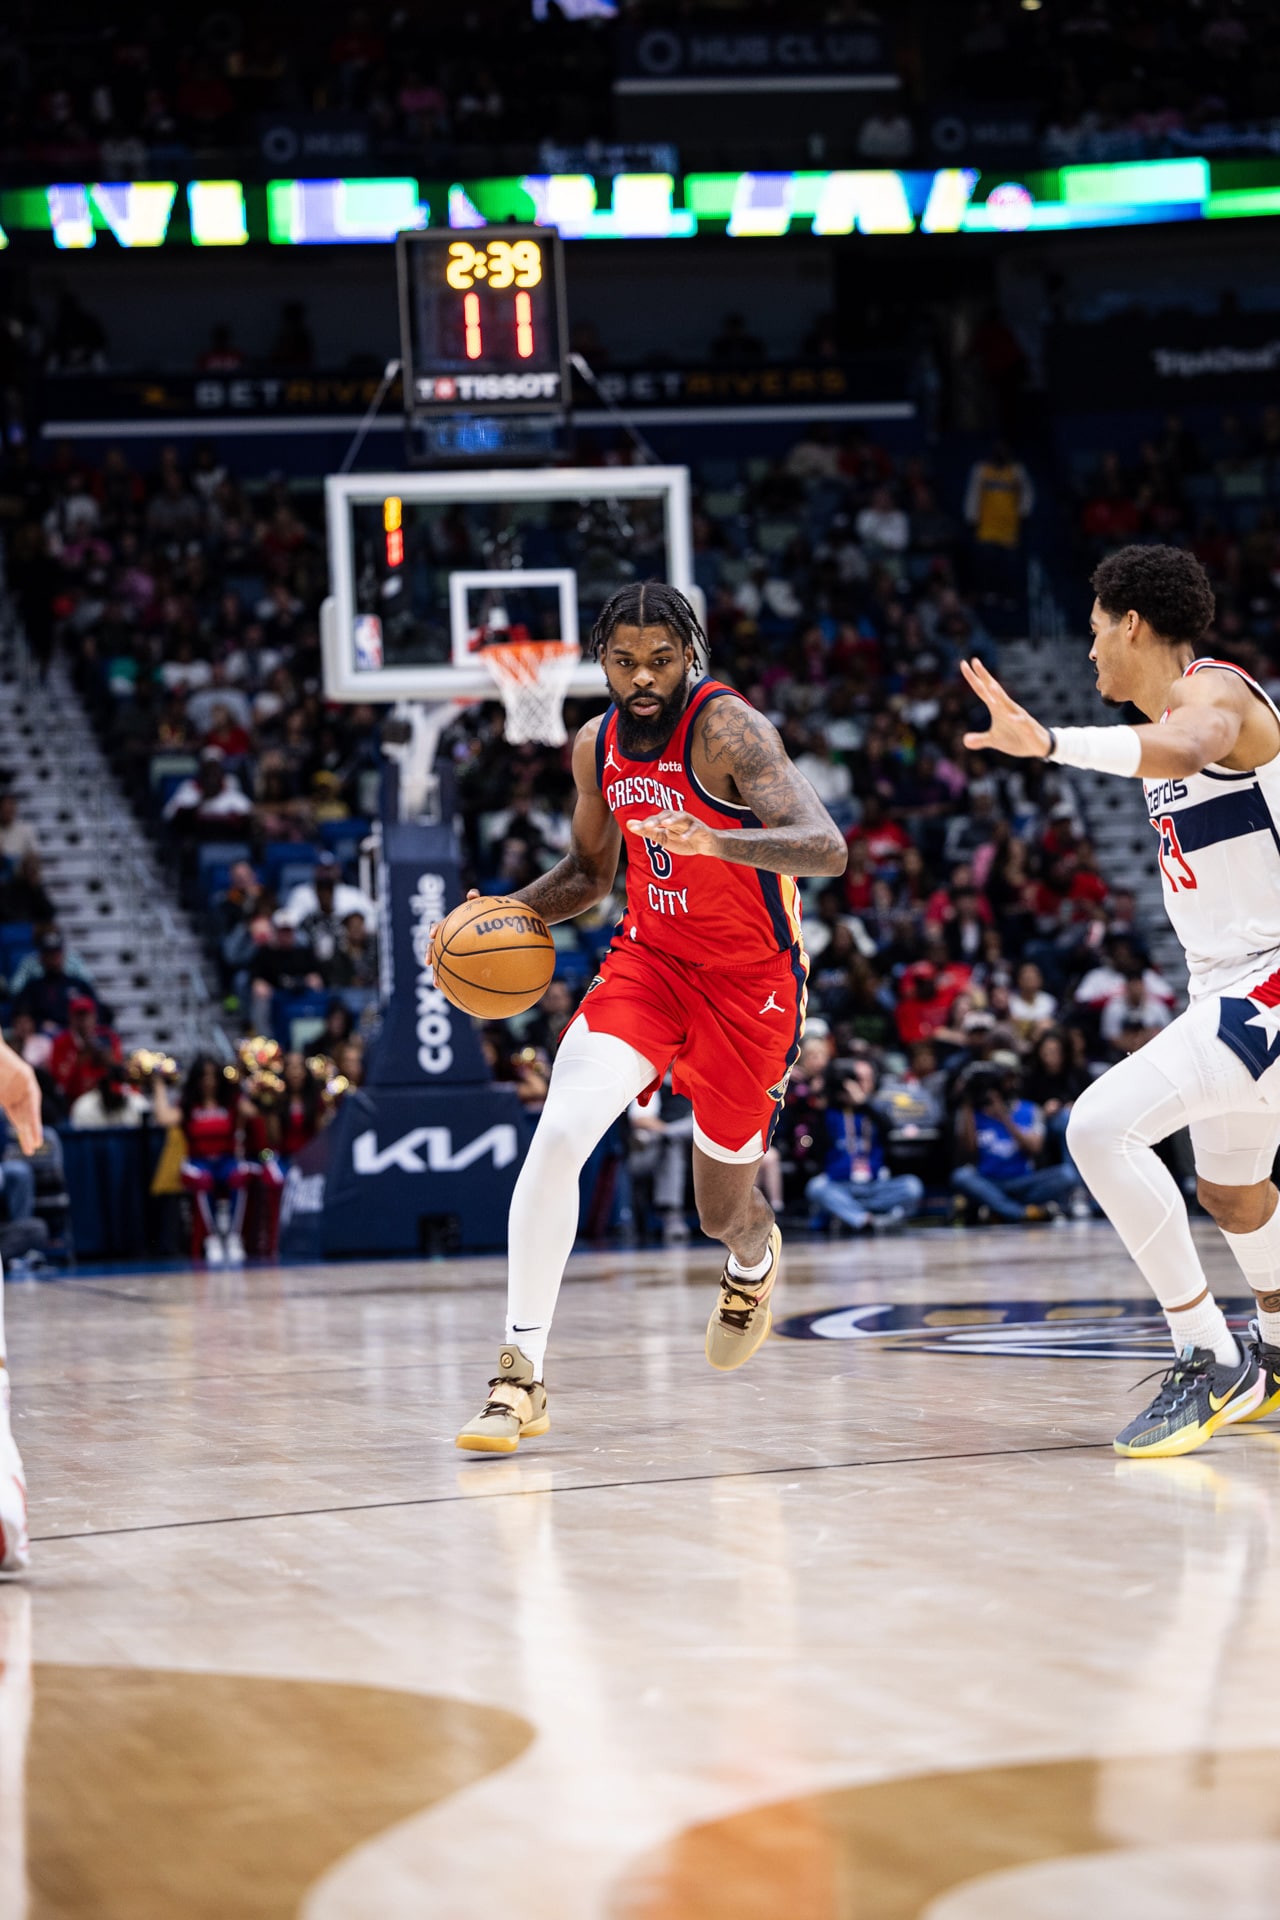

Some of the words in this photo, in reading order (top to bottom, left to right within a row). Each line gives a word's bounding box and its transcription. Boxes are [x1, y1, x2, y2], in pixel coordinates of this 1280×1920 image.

[446, 240, 542, 289] 2:39
[606, 776, 686, 813] CRESCENT
[648, 882, 689, 916] CITY
[475, 914, 550, 941] Wilson
